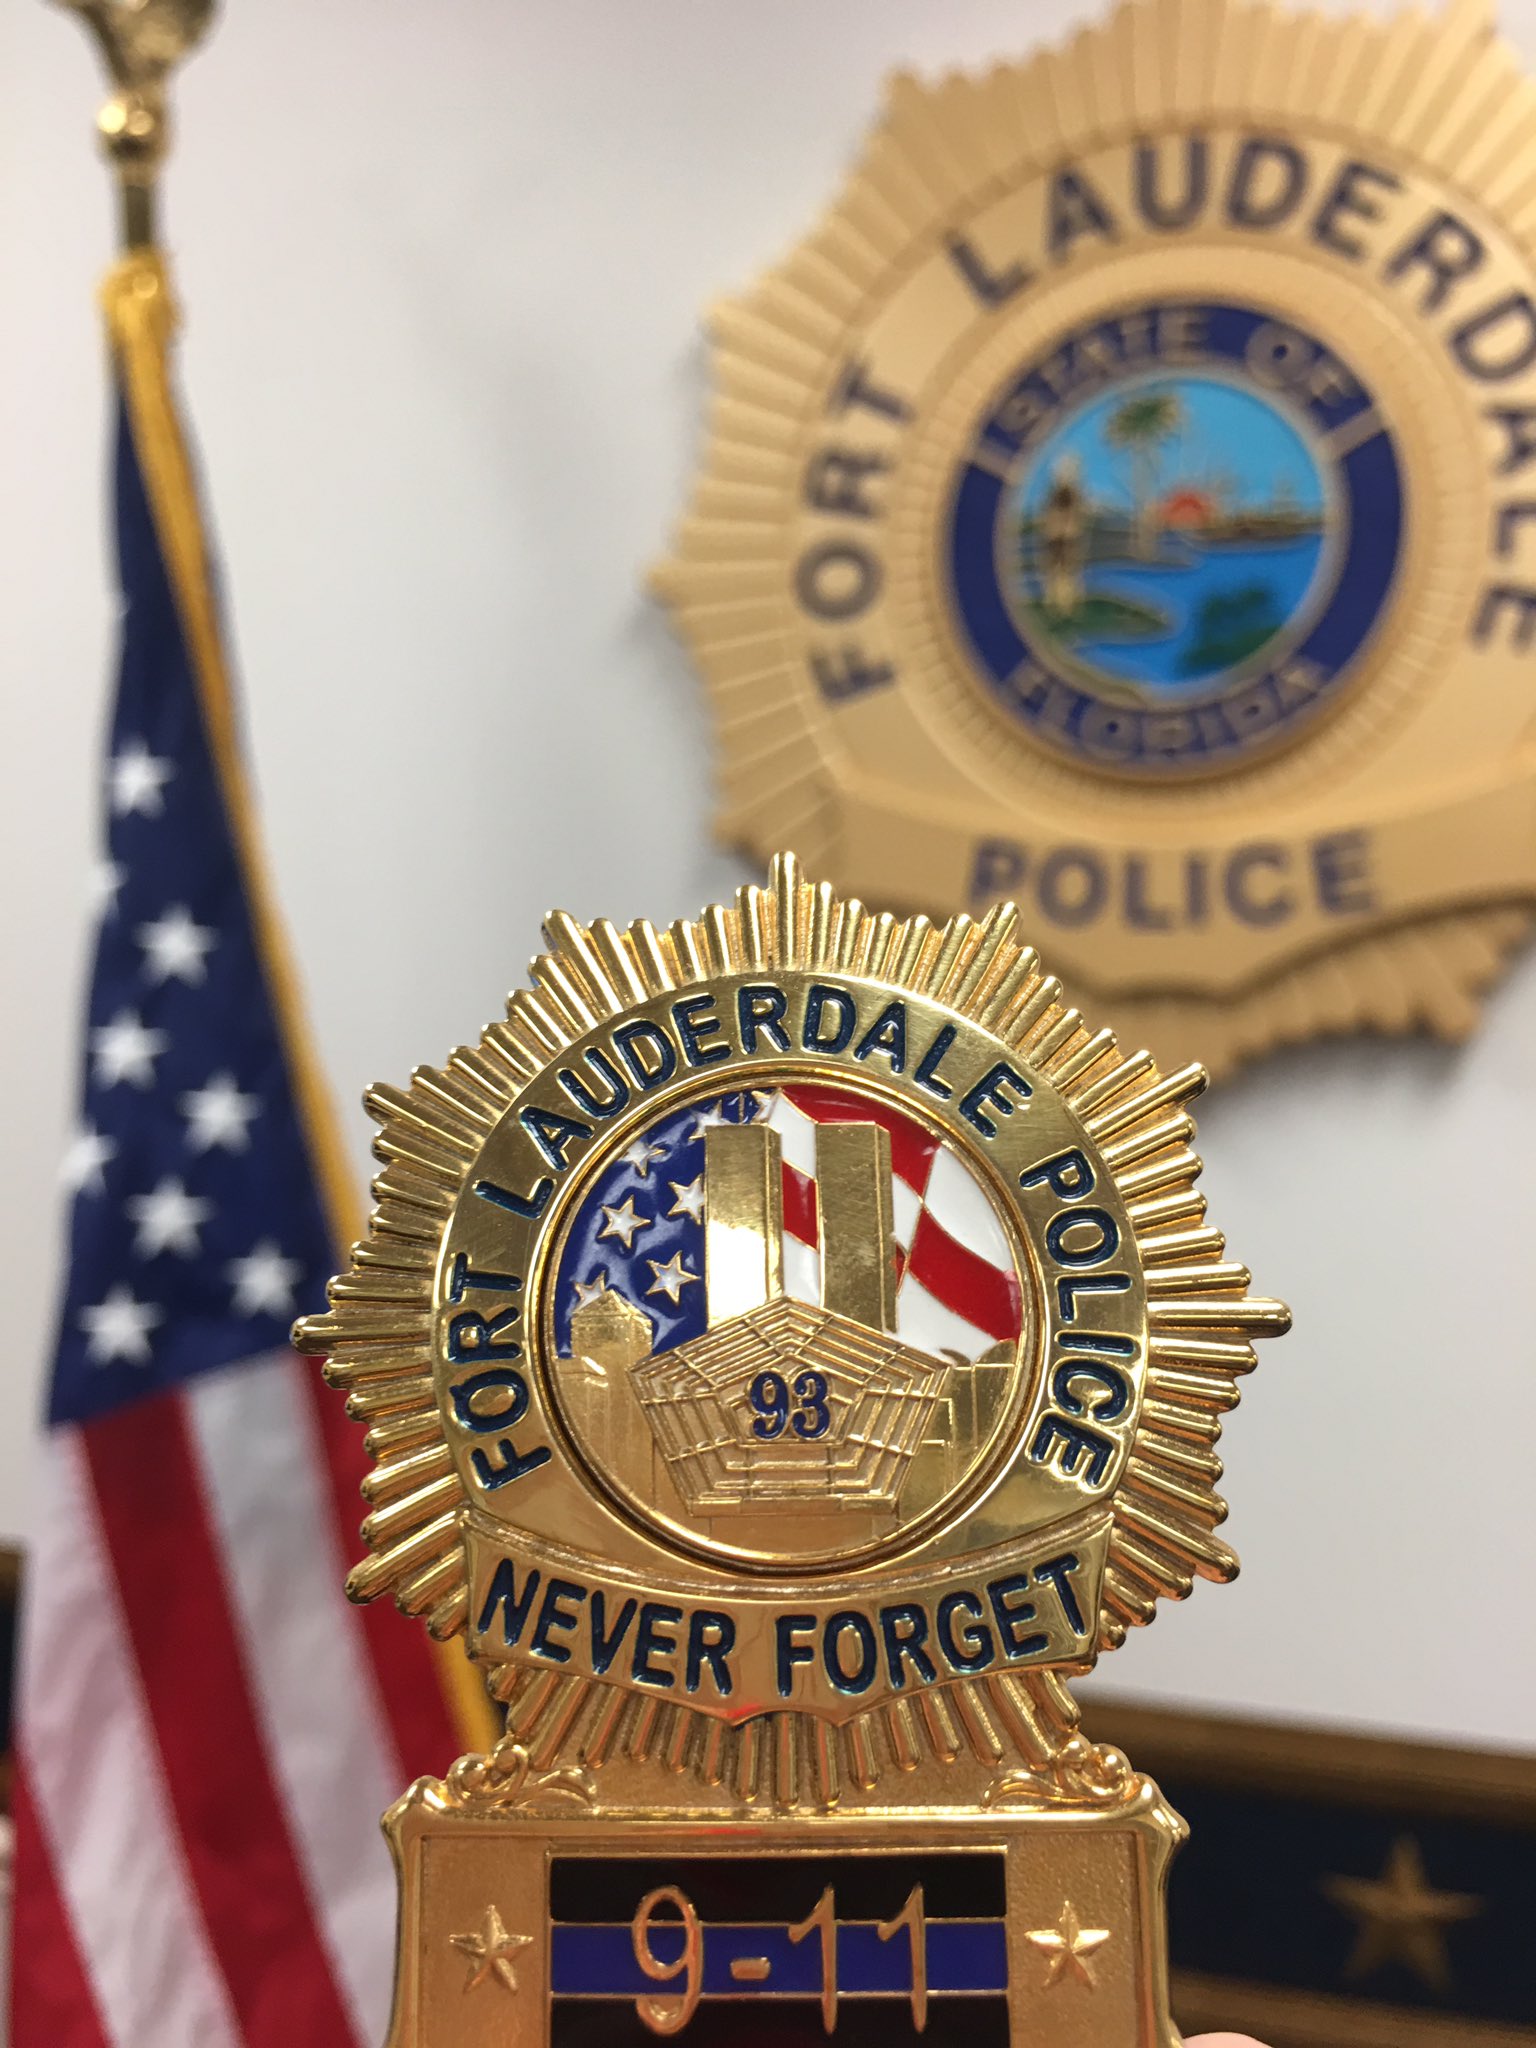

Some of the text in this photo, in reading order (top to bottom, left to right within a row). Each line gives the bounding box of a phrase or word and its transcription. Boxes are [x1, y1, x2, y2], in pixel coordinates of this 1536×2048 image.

[794, 134, 1536, 708] FORT LAUDERDALE
[1245, 318, 1352, 410] OF
[966, 828, 1374, 934] POLICE
[447, 982, 1133, 1492] FORT LAUDERDALE POLICE
[748, 1369, 832, 1440] 93
[476, 1552, 1101, 1698] NEVER FORGET
[631, 1880, 929, 2036] 9-11
